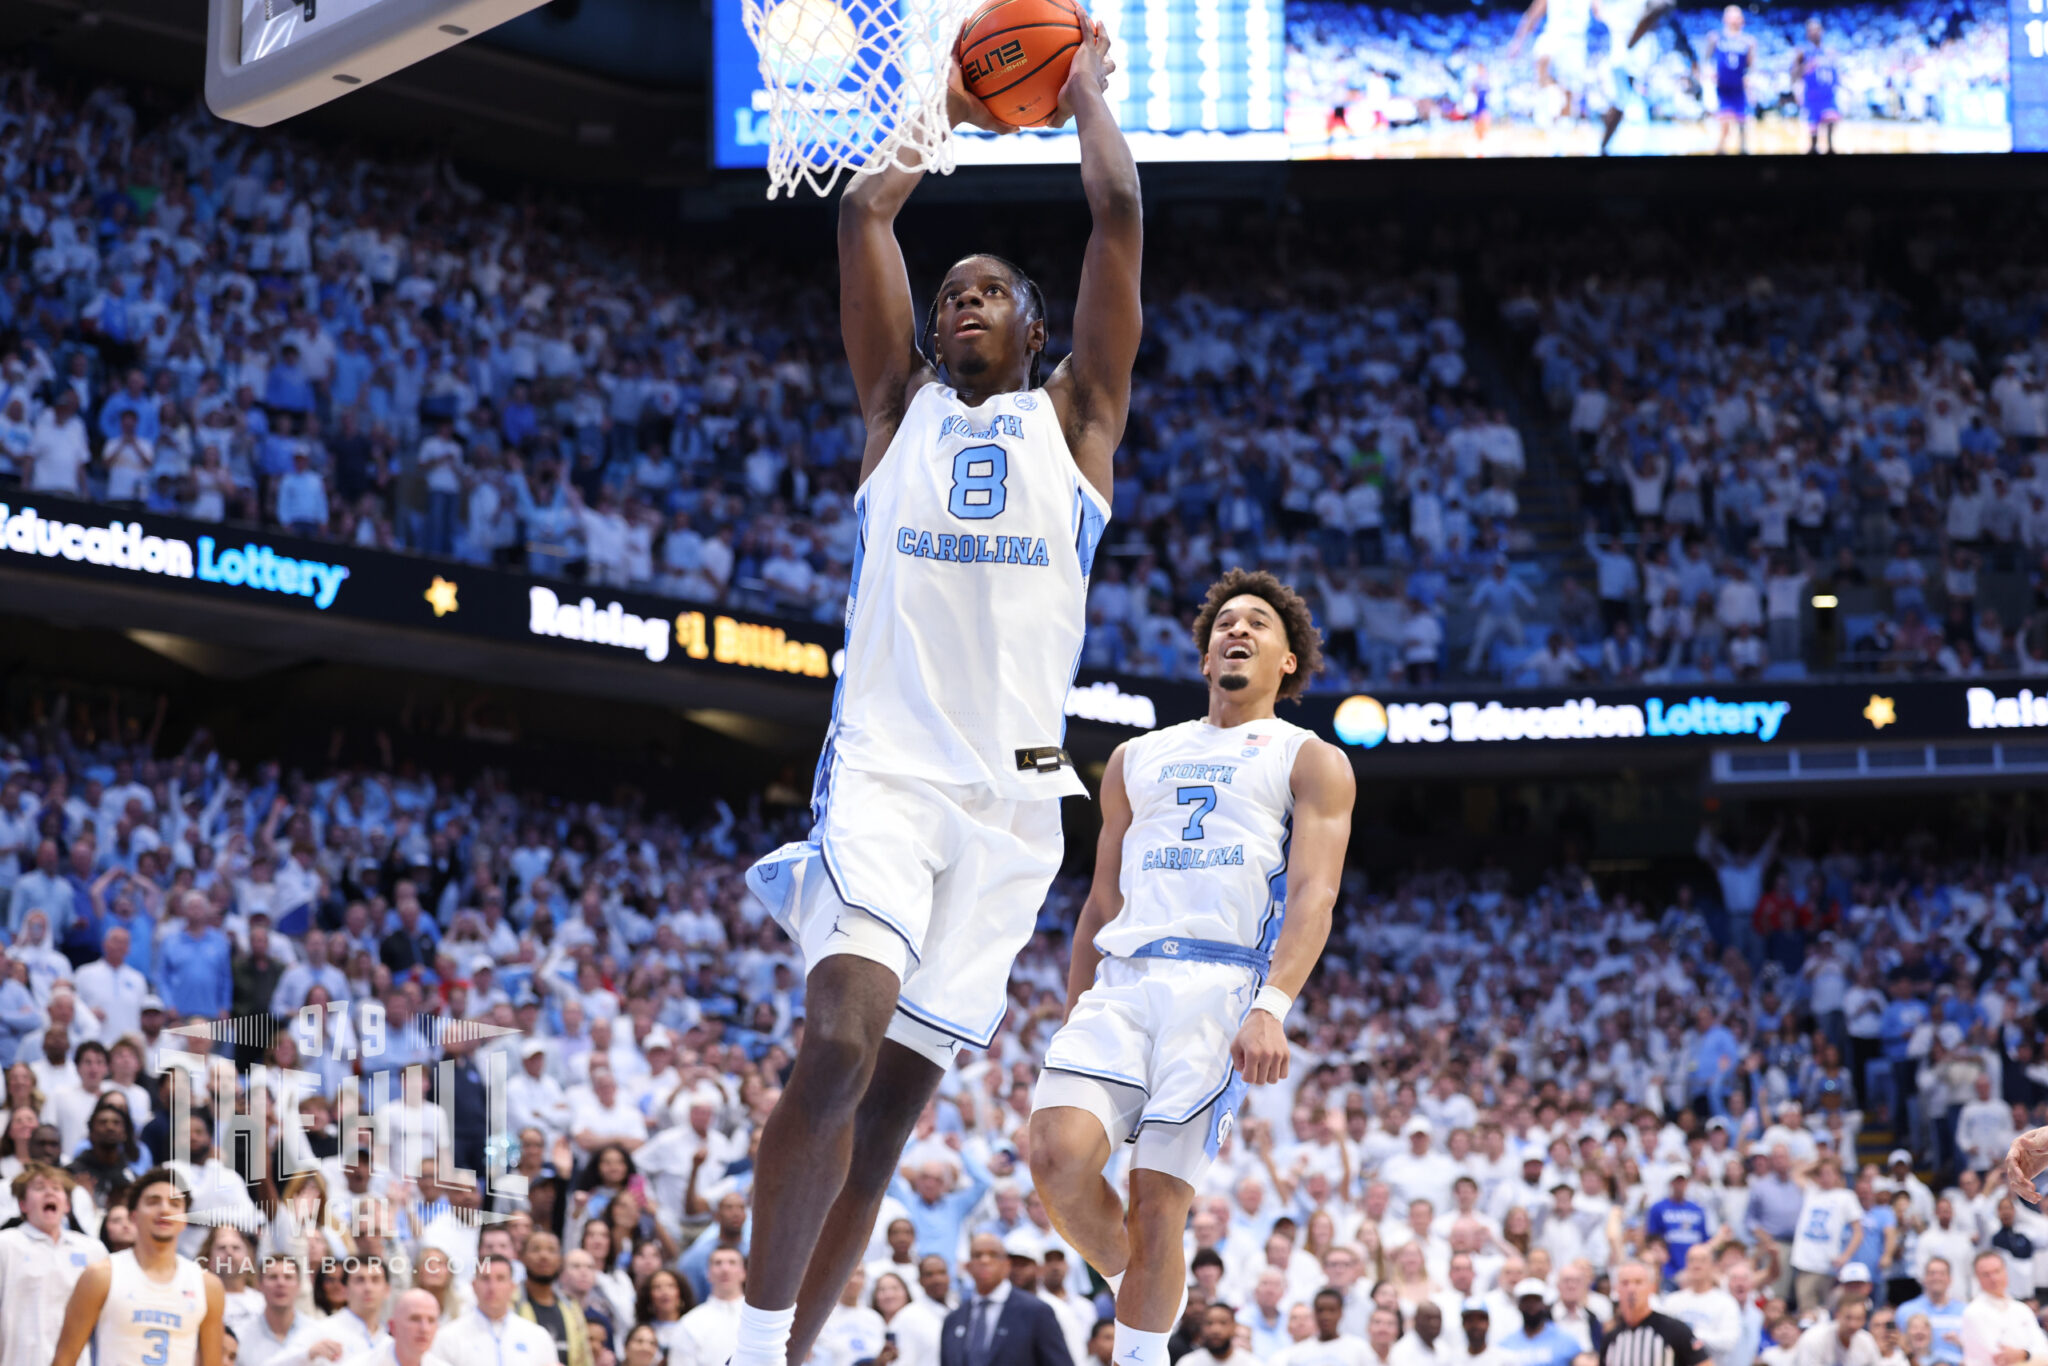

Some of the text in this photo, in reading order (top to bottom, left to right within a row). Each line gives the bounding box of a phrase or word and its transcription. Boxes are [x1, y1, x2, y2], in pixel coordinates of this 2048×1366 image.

[965, 39, 1025, 83] ELITE
[948, 443, 1008, 520] 8
[897, 526, 1050, 566] CAROLINA
[198, 535, 347, 609] Lottery
[676, 611, 709, 660] $1
[1387, 696, 1786, 743] NC Education Lottery
[1966, 687, 2048, 729] Rais
[1158, 763, 1237, 784] NORTH
[1177, 785, 1218, 841] 7
[1142, 844, 1244, 871] CAROLINA
[141, 1329, 170, 1366] 3
